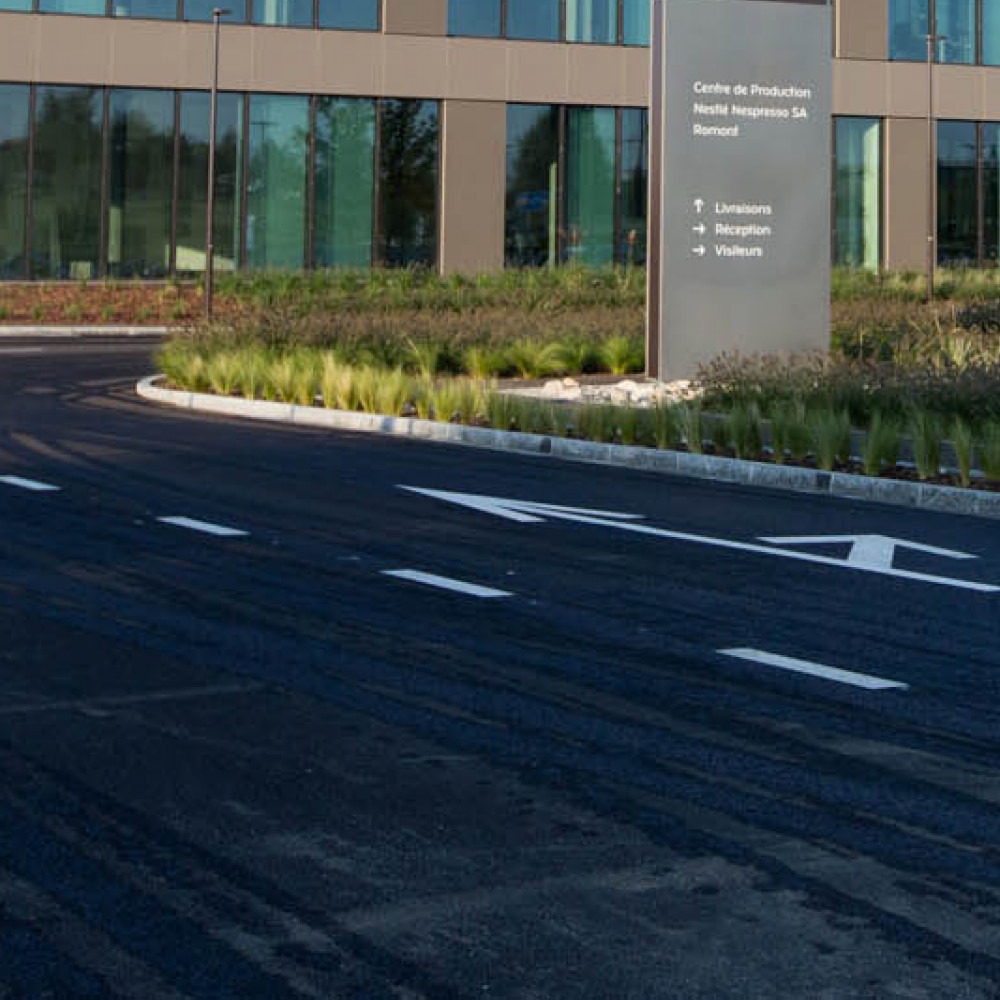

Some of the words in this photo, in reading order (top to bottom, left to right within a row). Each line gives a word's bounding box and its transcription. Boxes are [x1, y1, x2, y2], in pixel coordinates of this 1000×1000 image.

[693, 81, 731, 95] Centre
[733, 83, 748, 96] de
[750, 84, 812, 99] Production
[731, 105, 789, 119] Nespresso
[791, 106, 807, 118] SA
[693, 124, 739, 137] Romont
[715, 202, 772, 215] Livraisons
[715, 244, 763, 257] Visiteurs
